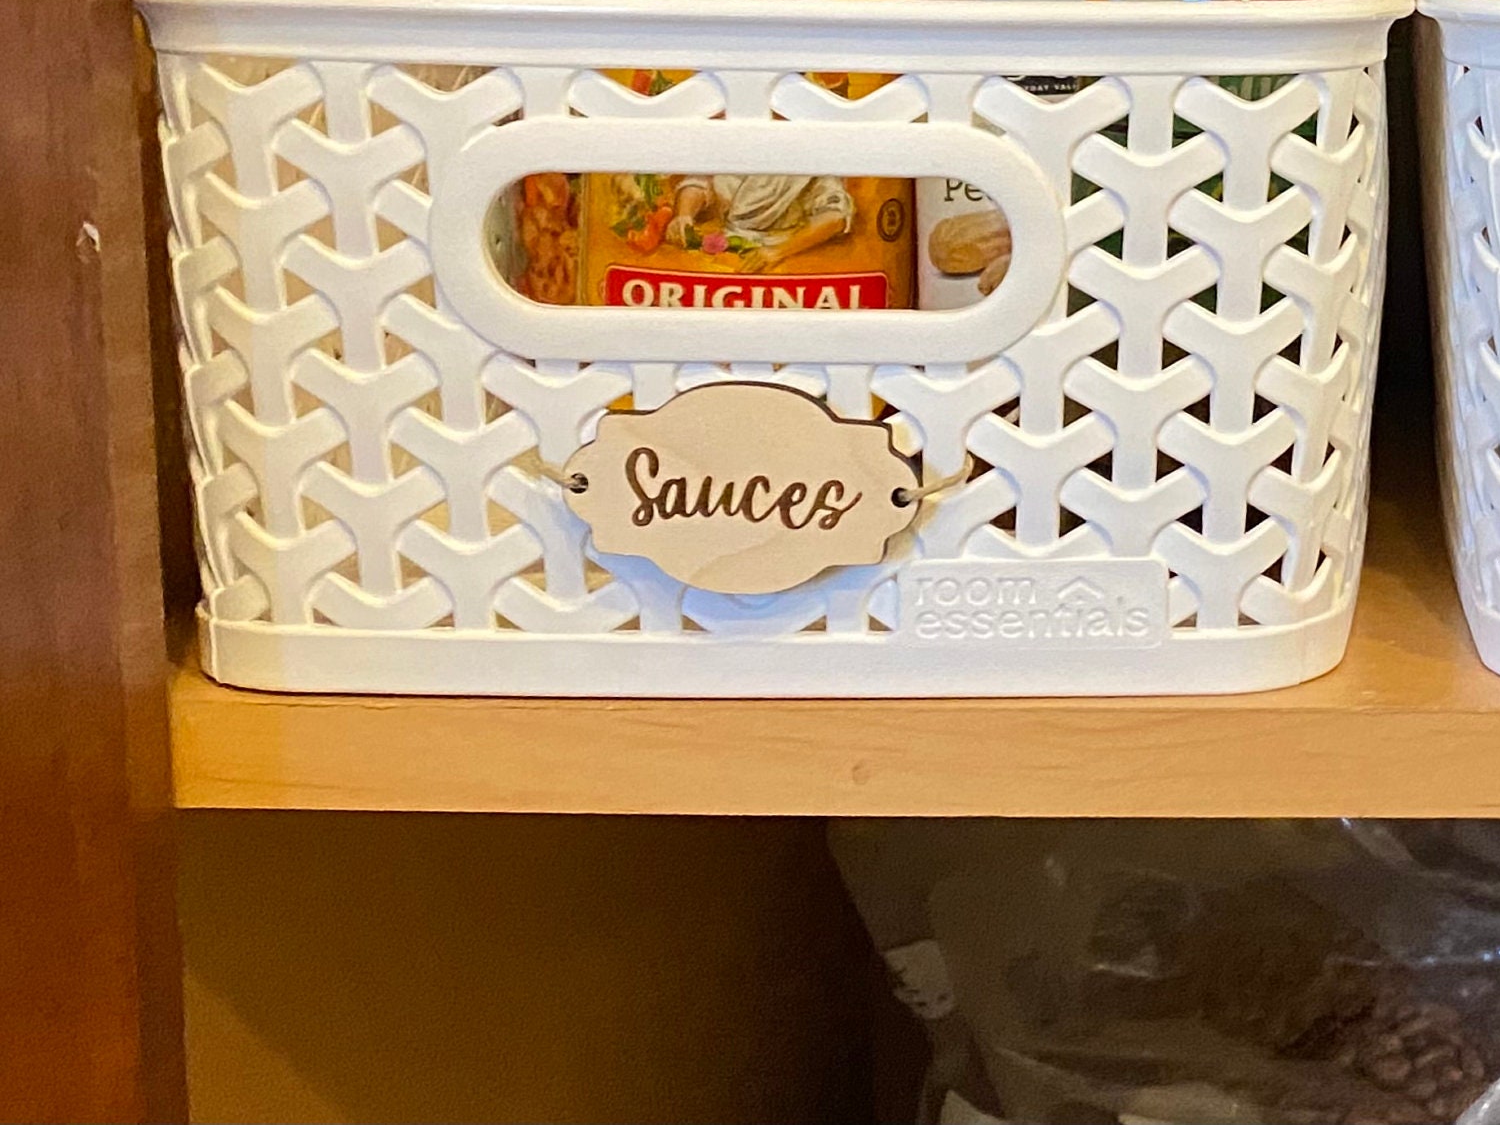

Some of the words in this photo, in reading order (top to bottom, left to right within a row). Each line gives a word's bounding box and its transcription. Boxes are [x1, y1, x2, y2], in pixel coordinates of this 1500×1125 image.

[622, 279, 868, 309] ORIGINAL
[625, 447, 862, 530] Sauces
[914, 576, 1037, 606] room
[915, 596, 1150, 640] essentials
